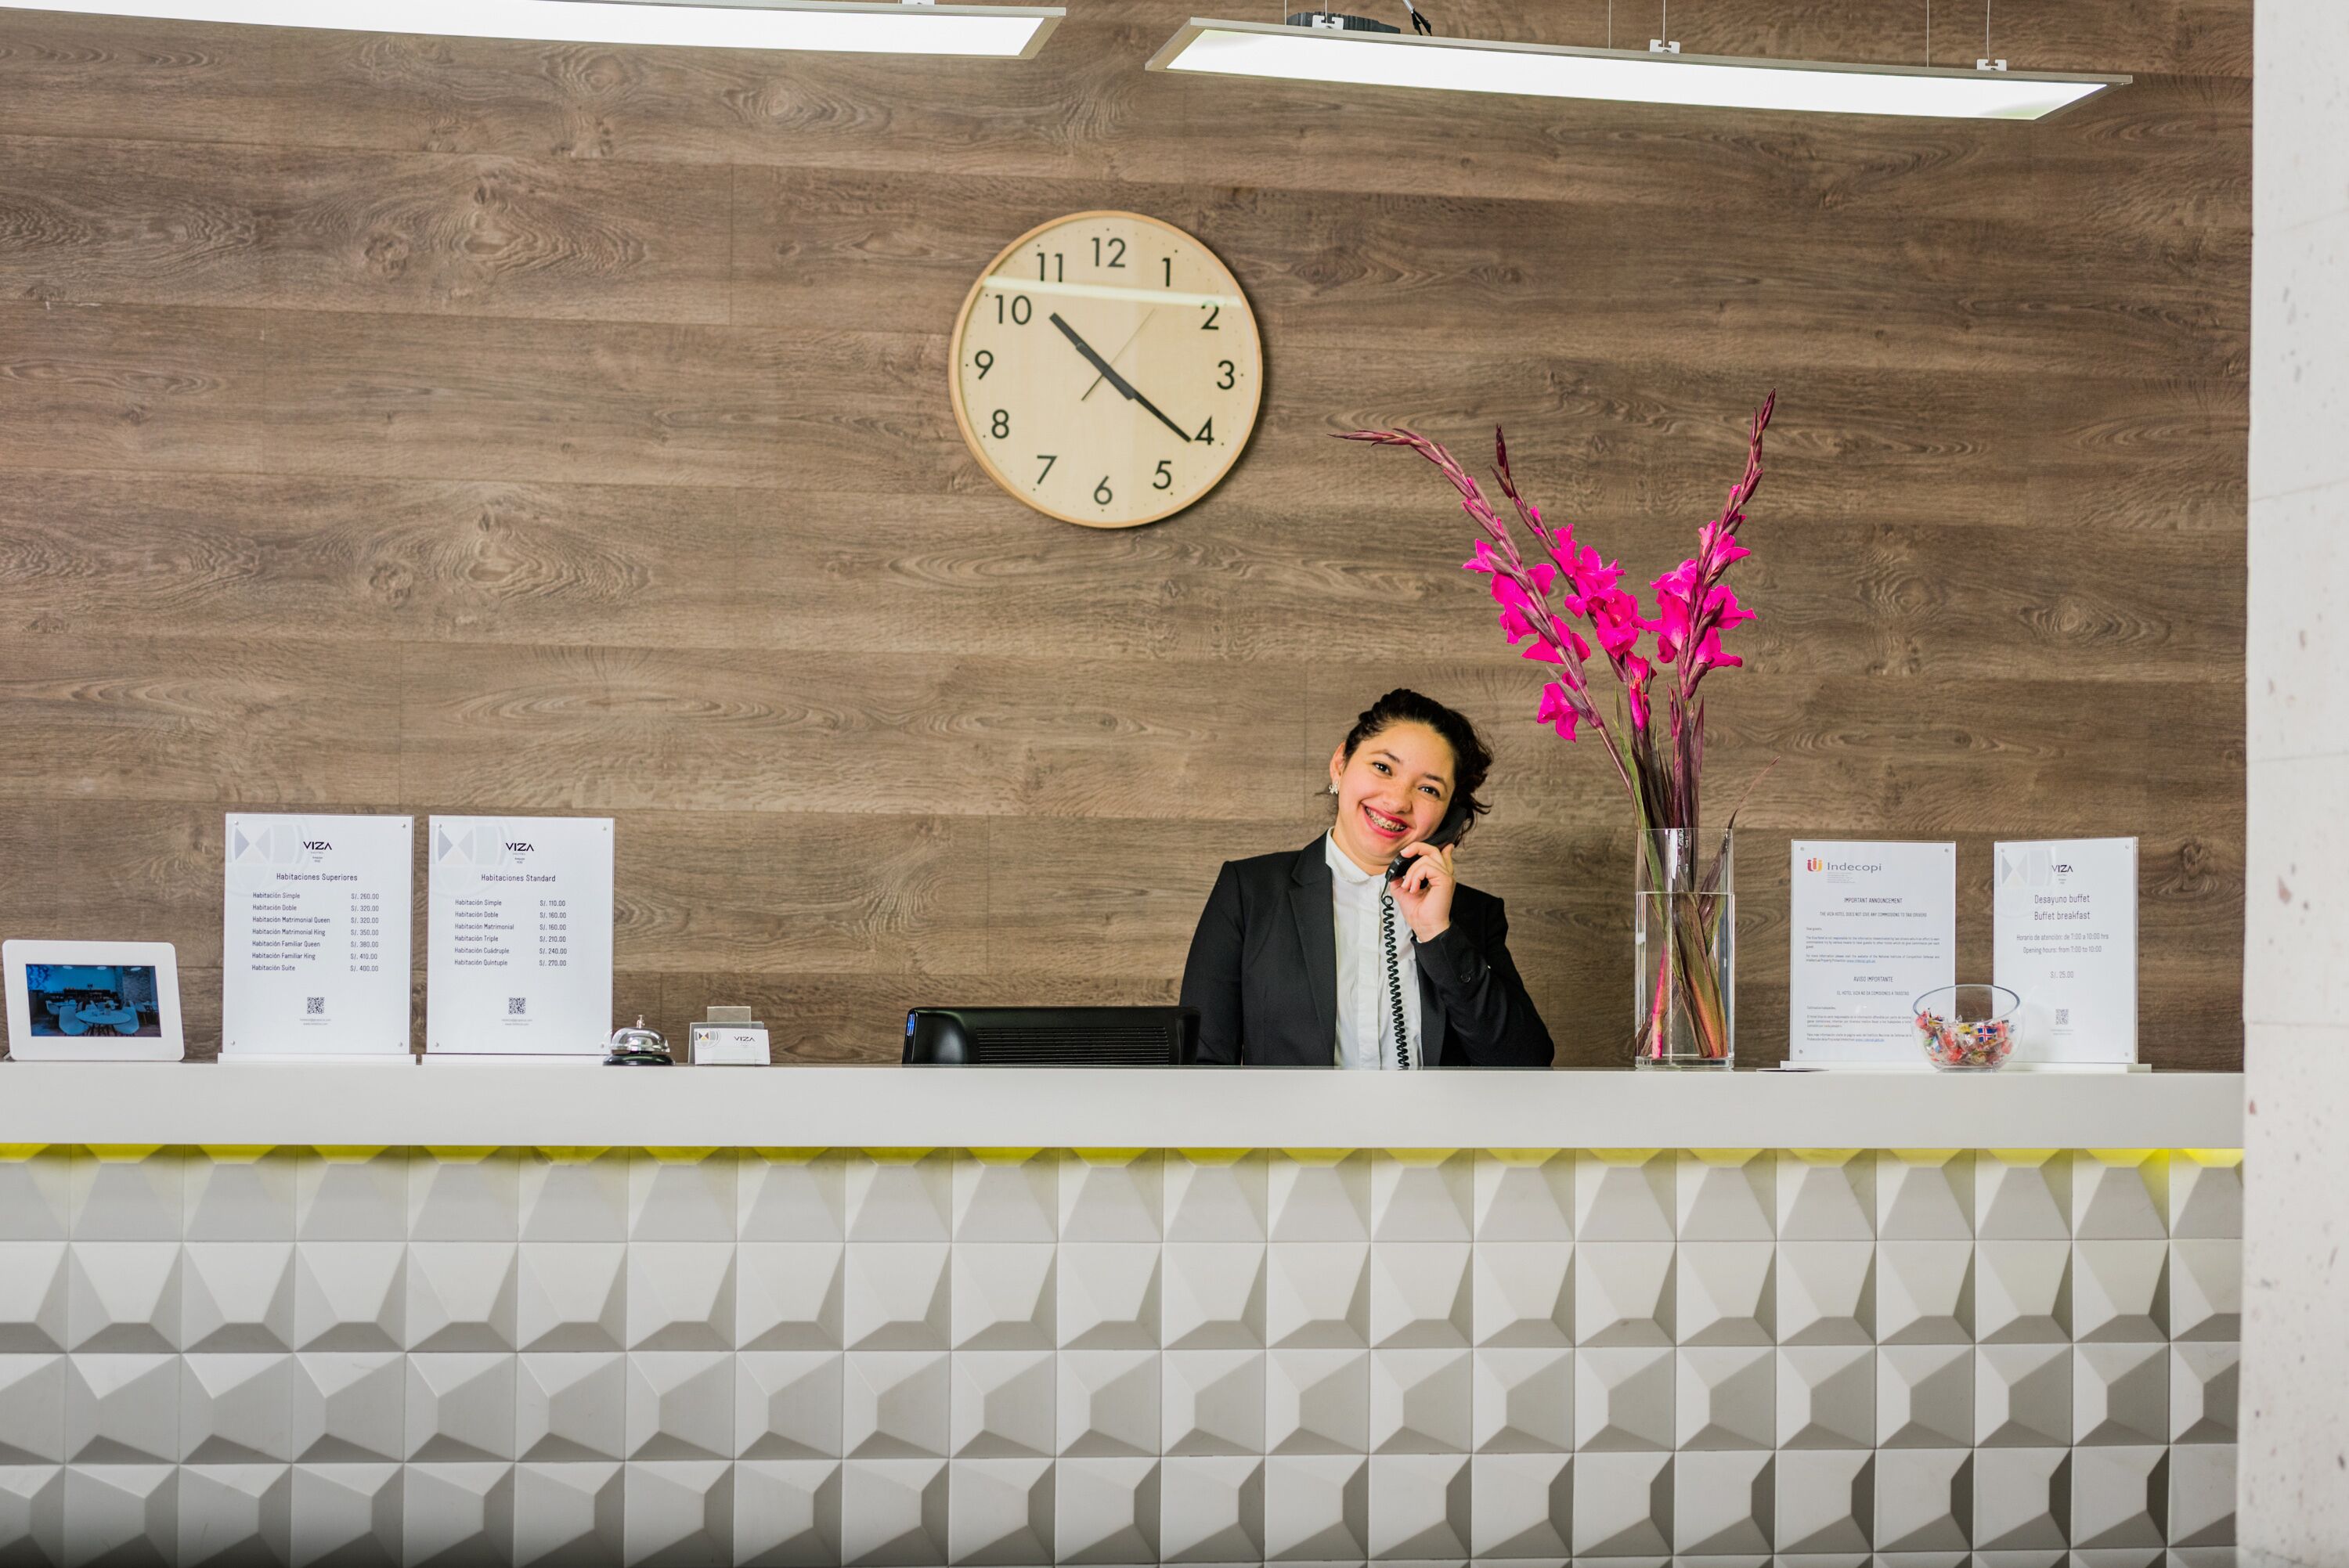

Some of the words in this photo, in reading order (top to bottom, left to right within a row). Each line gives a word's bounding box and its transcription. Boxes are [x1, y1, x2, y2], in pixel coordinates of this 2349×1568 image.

[1036, 252, 1064, 283] 11
[1091, 237, 1126, 269] 12
[1162, 257, 1171, 287] 1
[994, 294, 1032, 326] 10
[1200, 300, 1220, 330] 2
[974, 349, 994, 380] 9
[1216, 360, 1235, 390] 3
[991, 409, 1009, 439] 8
[1194, 415, 1214, 445] 4
[1036, 455, 1058, 485] 7
[1152, 460, 1172, 490] 5
[1093, 475, 1113, 505] 6
[303, 841, 333, 850] VIZA
[505, 842, 534, 852] VIZA
[322, 873, 358, 882] Superiores
[1828, 862, 1882, 874] Indecopi
[2051, 864, 2073, 873] VIZA
[2034, 895, 2067, 906] Desayuno
[2069, 893, 2090, 903] buffet
[2034, 911, 2055, 921] Buffet
[2057, 910, 2090, 920] breakfast
[2023, 946, 2041, 955] Opening
